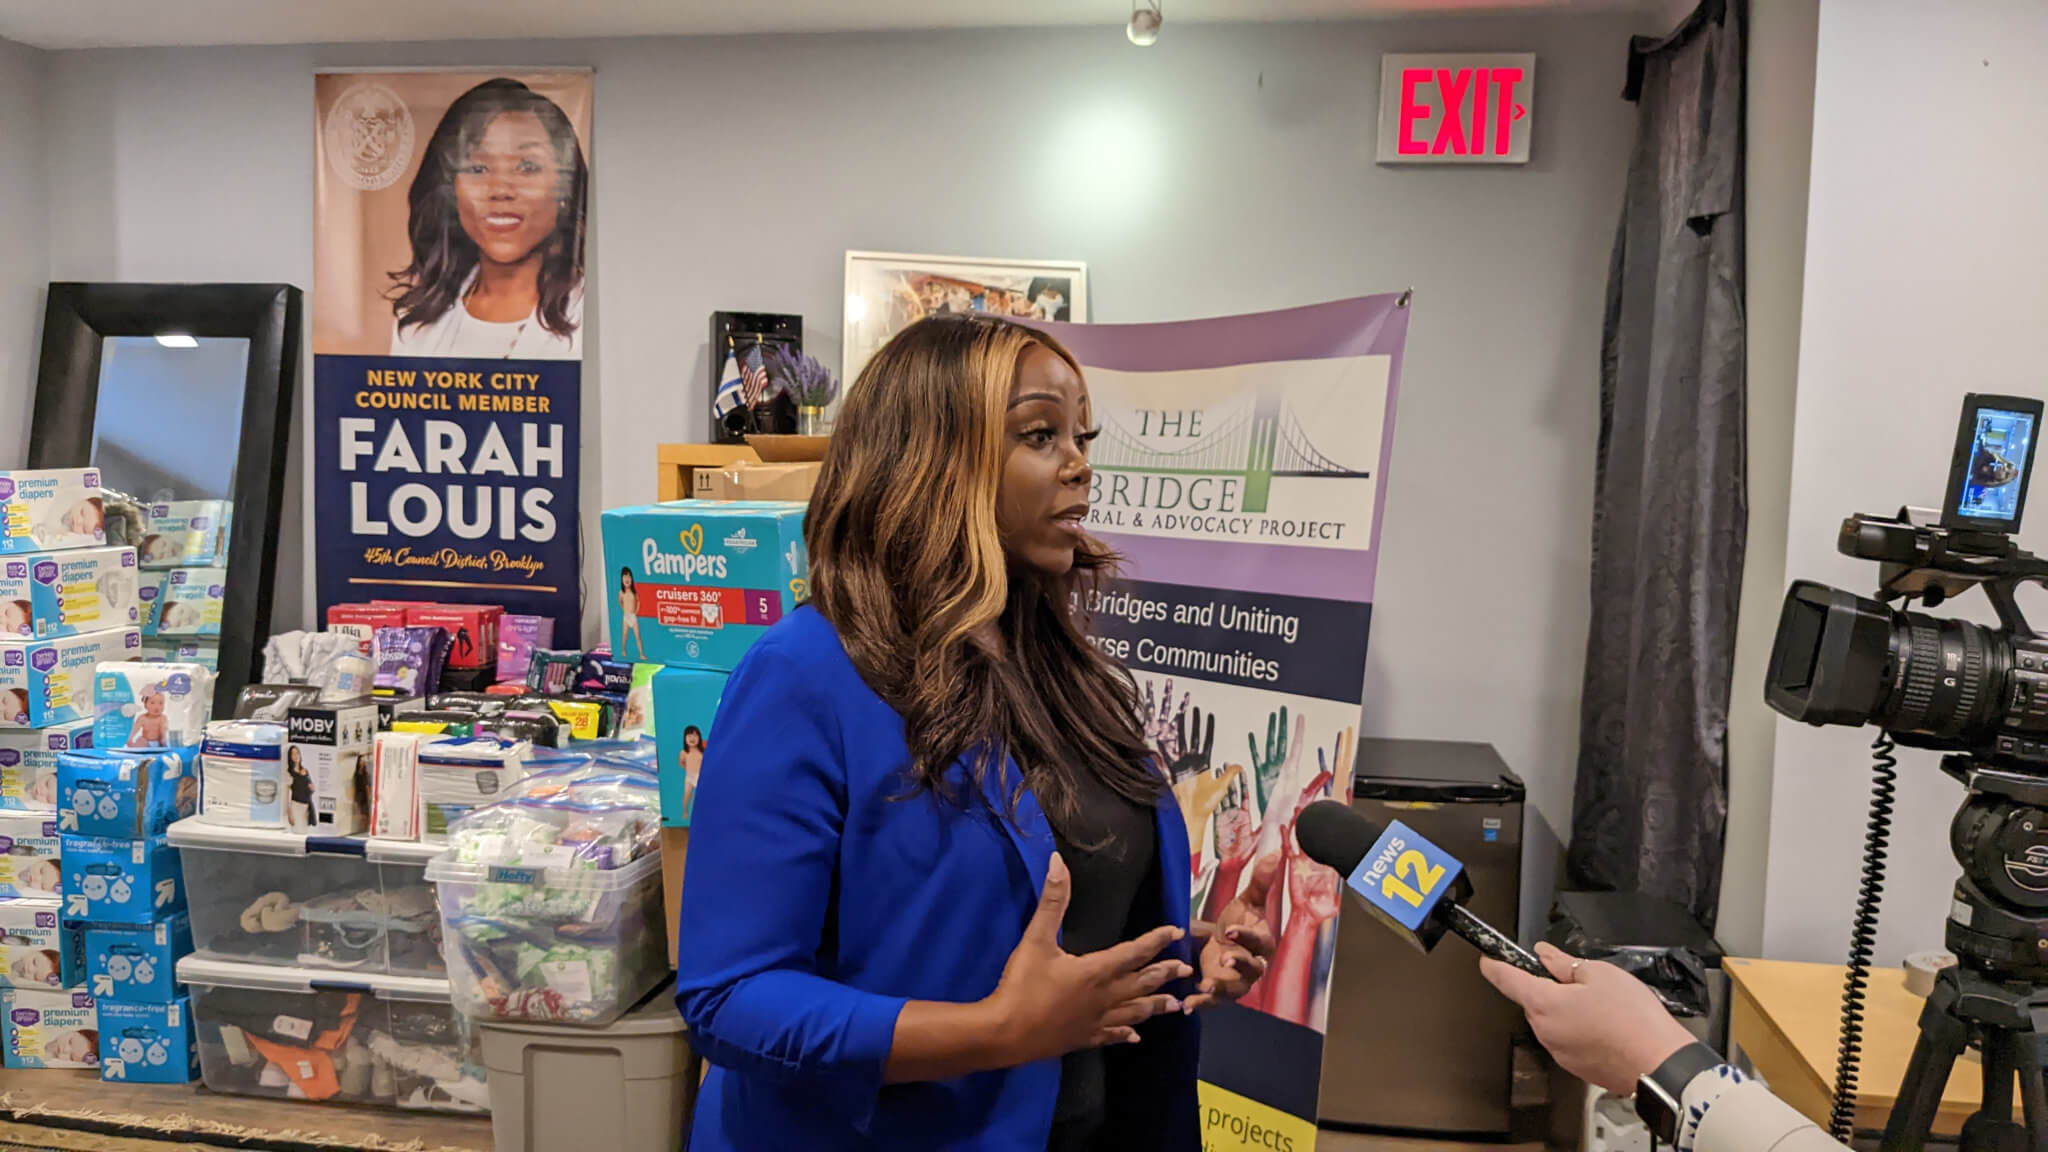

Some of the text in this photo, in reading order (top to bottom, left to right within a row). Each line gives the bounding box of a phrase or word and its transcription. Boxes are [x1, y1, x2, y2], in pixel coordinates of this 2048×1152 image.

[1398, 68, 1523, 155] EXIT
[367, 370, 540, 391] NEW YORK CITY
[355, 391, 550, 413] COUNCIL MEMBER
[1135, 409, 1204, 438] THE
[339, 417, 563, 478] FARAH
[18, 478, 58, 490] premium
[19, 489, 54, 500] diapers
[1088, 473, 1239, 513] BRIDGE
[351, 481, 556, 542] LOUIS
[1082, 508, 1346, 540] RAL & ADVOCACY PROJECT
[61, 560, 98, 572] premium
[364, 547, 545, 578] 45th Council District, Brooklyn
[642, 538, 727, 582] Pampers
[62, 571, 93, 582] diapers
[656, 587, 698, 600] cruisers
[759, 597, 768, 613] 5
[1086, 589, 1168, 624] Bridges
[1172, 601, 1214, 627] and
[1219, 604, 1299, 644] Uniting
[61, 643, 100, 657] premium
[1137, 638, 1280, 682] Communities
[62, 655, 95, 668] diapers
[290, 717, 334, 733] MOBY
[24, 751, 57, 760] premiu
[17, 837, 59, 847] premium
[1362, 837, 1406, 886] news
[1381, 849, 1446, 908] 12
[9, 928, 51, 938] premium
[44, 1009, 89, 1018] premium
[44, 1018, 83, 1027] diapers
[1207, 1106, 1294, 1152] projects
